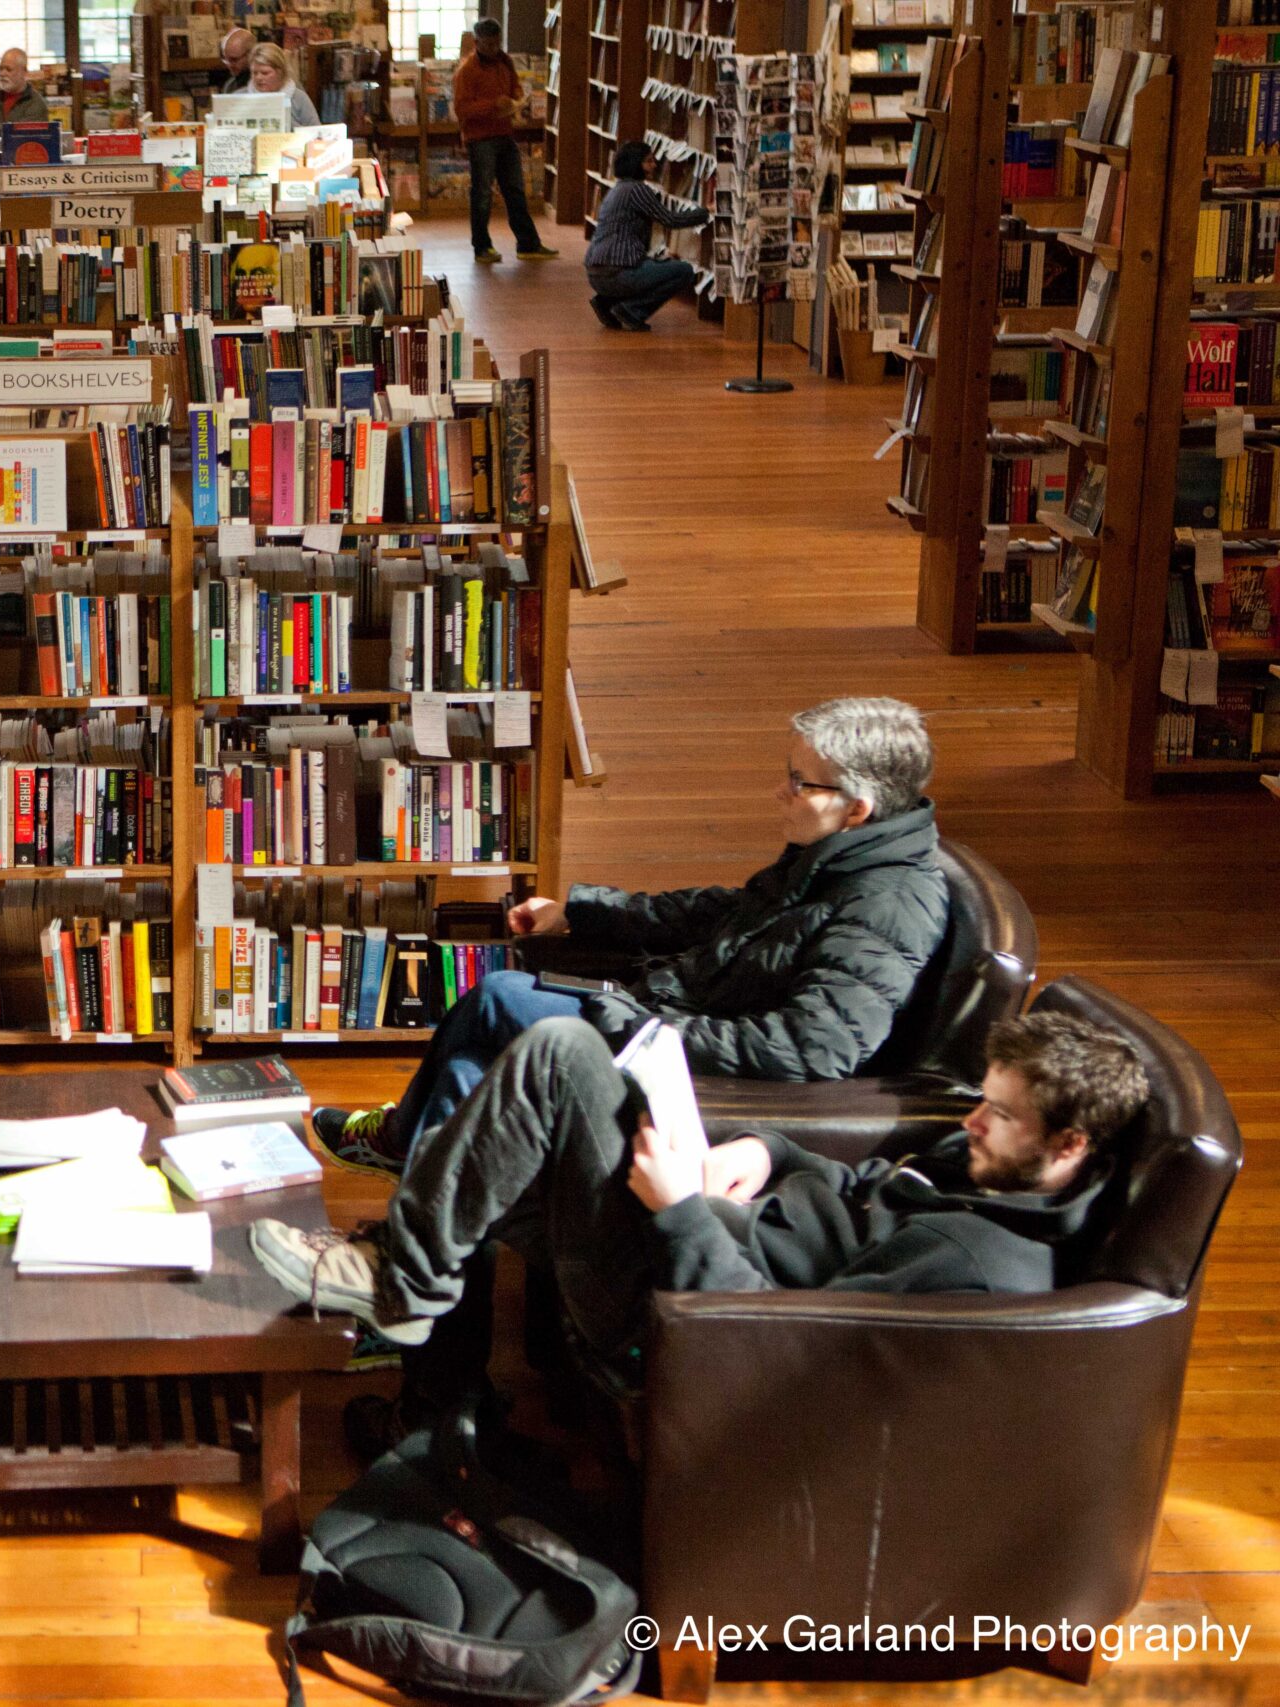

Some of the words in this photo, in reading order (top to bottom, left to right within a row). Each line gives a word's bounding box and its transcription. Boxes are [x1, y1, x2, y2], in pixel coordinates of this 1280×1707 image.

[8, 171, 57, 189] Essays
[62, 171, 75, 184] &
[83, 170, 149, 185] Criticism
[60, 201, 127, 224] Poetry
[236, 288, 274, 297] POETRY
[1187, 340, 1235, 364] Wolf
[3, 371, 143, 389] BOOKSHELVES
[1184, 362, 1232, 393] Hall
[197, 412, 209, 460] INFINITE
[198, 463, 209, 489] JEST
[270, 641, 279, 680] Mockingbird
[19, 775, 31, 815] CHABON
[336, 790, 347, 824] Tender
[126, 815, 136, 836] bovine
[422, 807, 431, 843] caucasia
[235, 927, 247, 963] PRIZE
